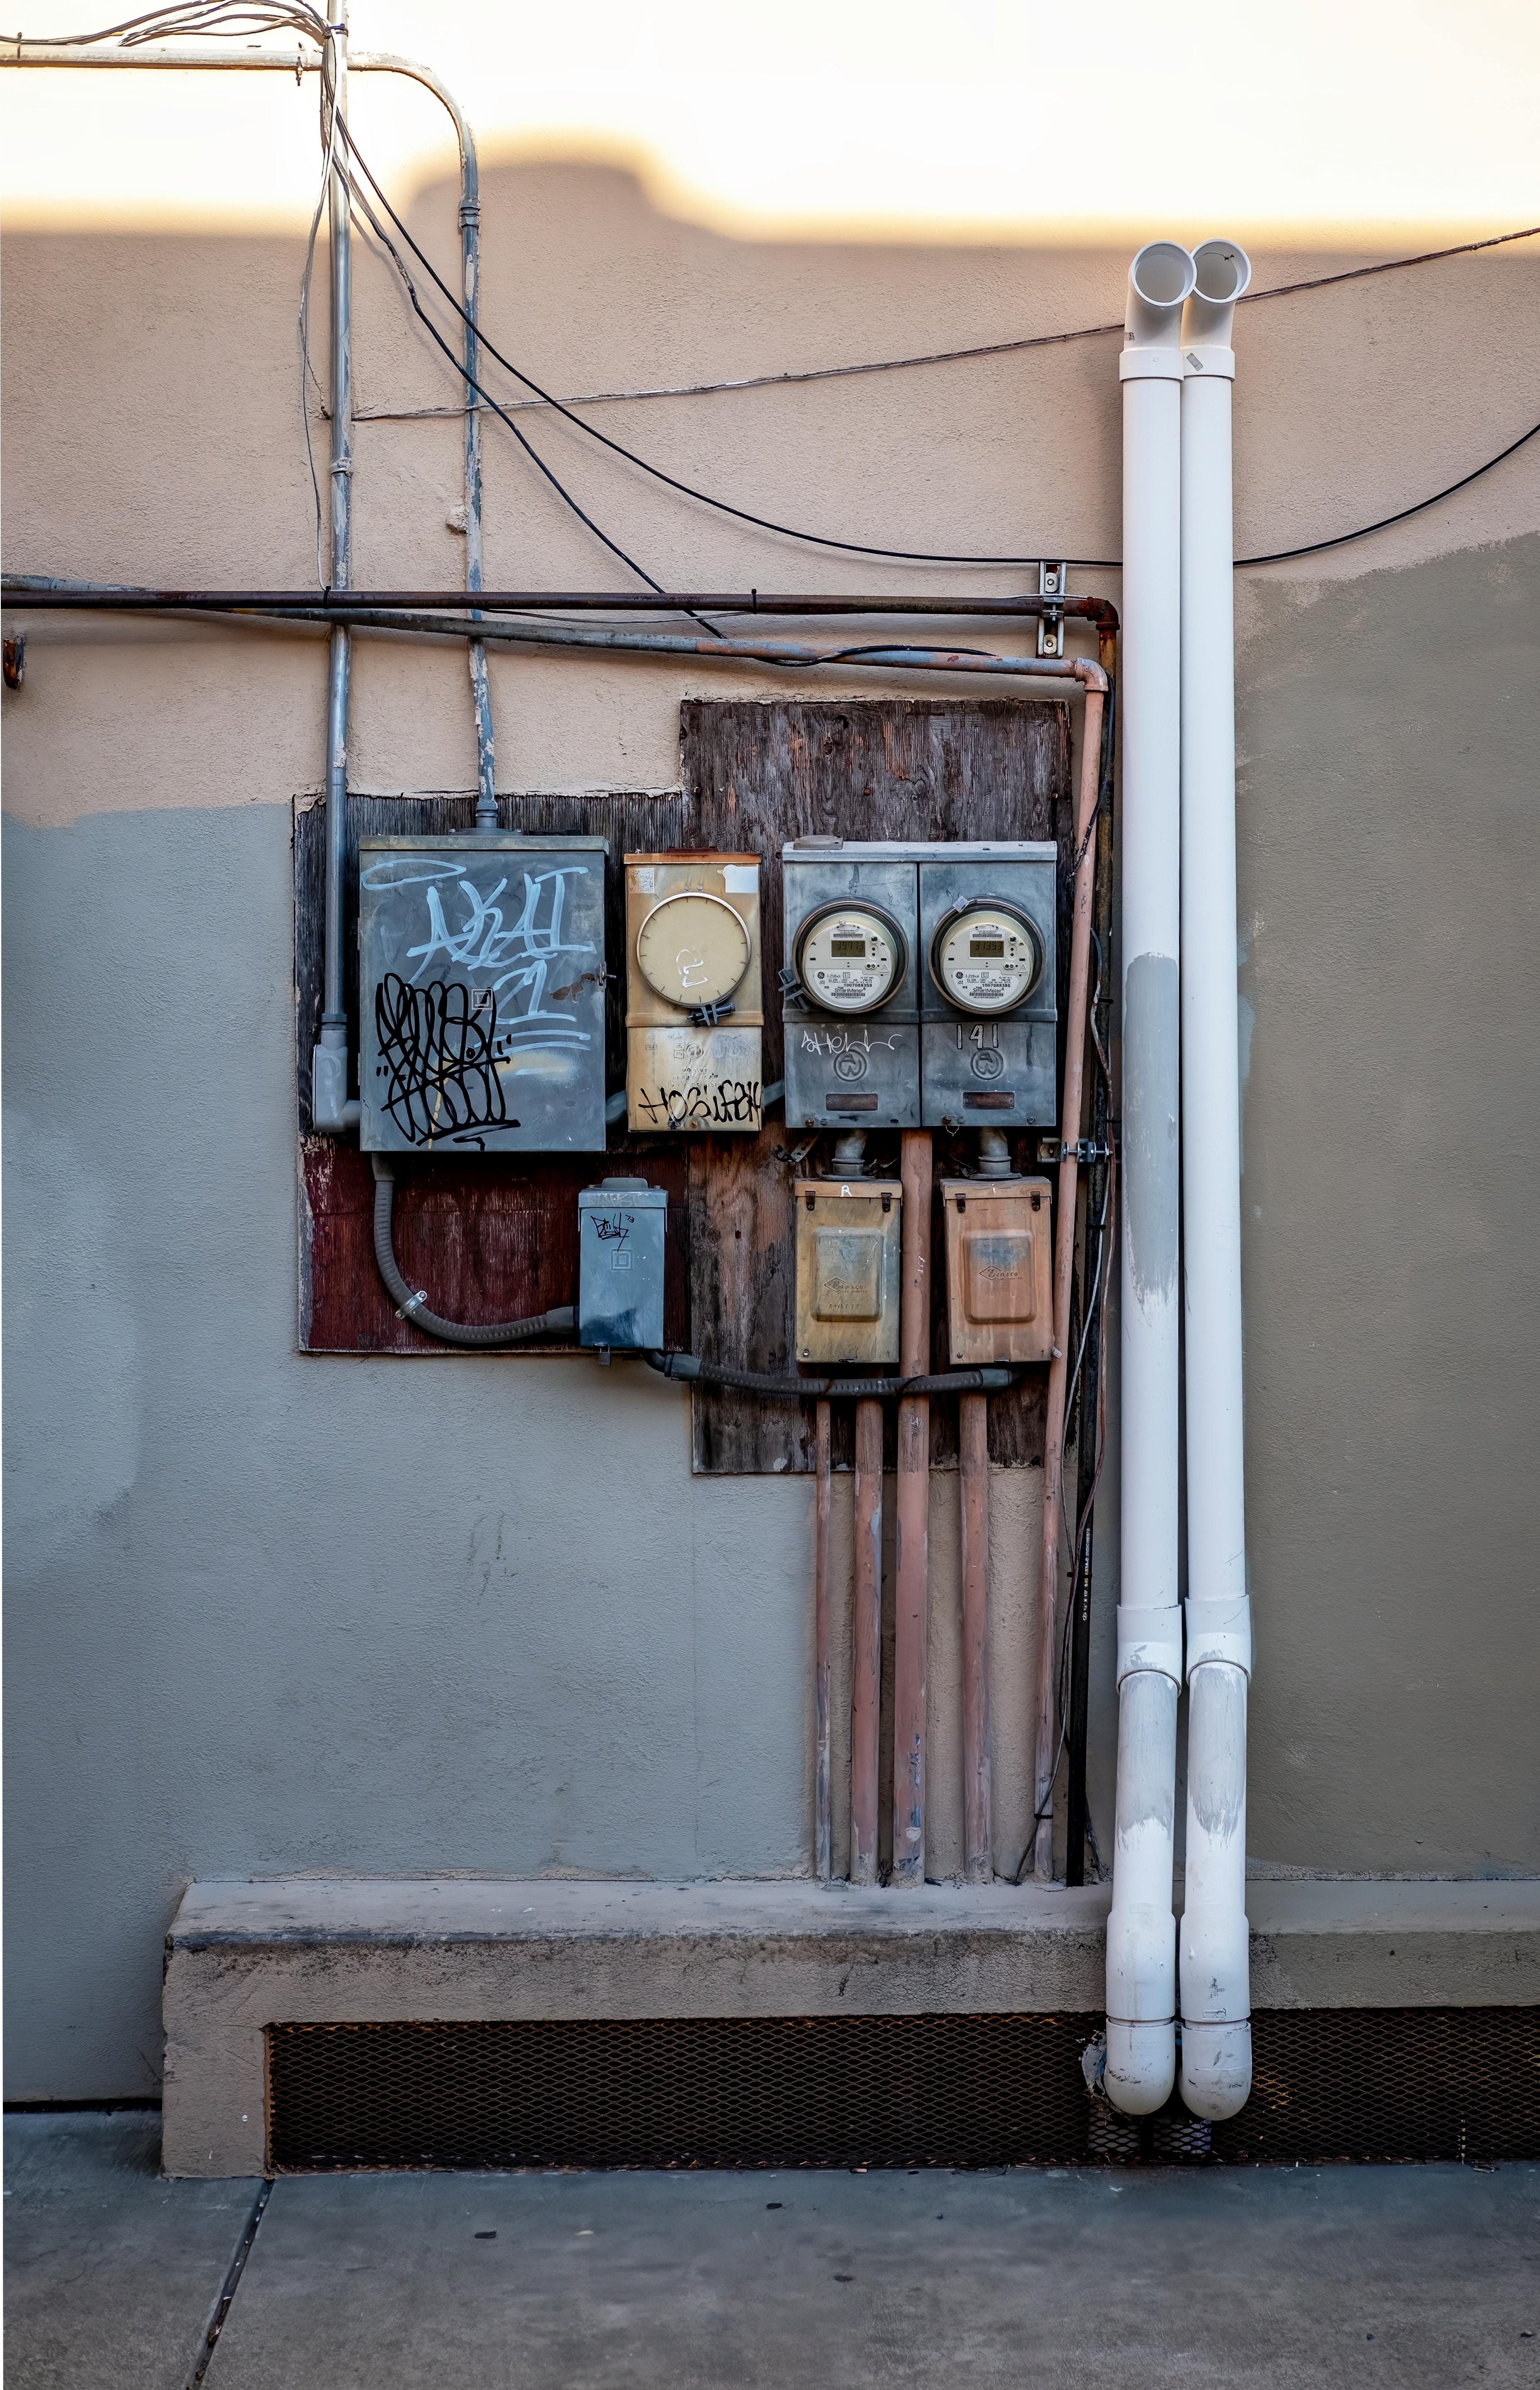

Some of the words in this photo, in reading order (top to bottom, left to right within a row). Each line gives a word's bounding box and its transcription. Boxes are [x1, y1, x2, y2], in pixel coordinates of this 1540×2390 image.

[956, 1023, 999, 1049] 141
[840, 1185, 852, 1197] R
[988, 1269, 1018, 1277] Zinsco
